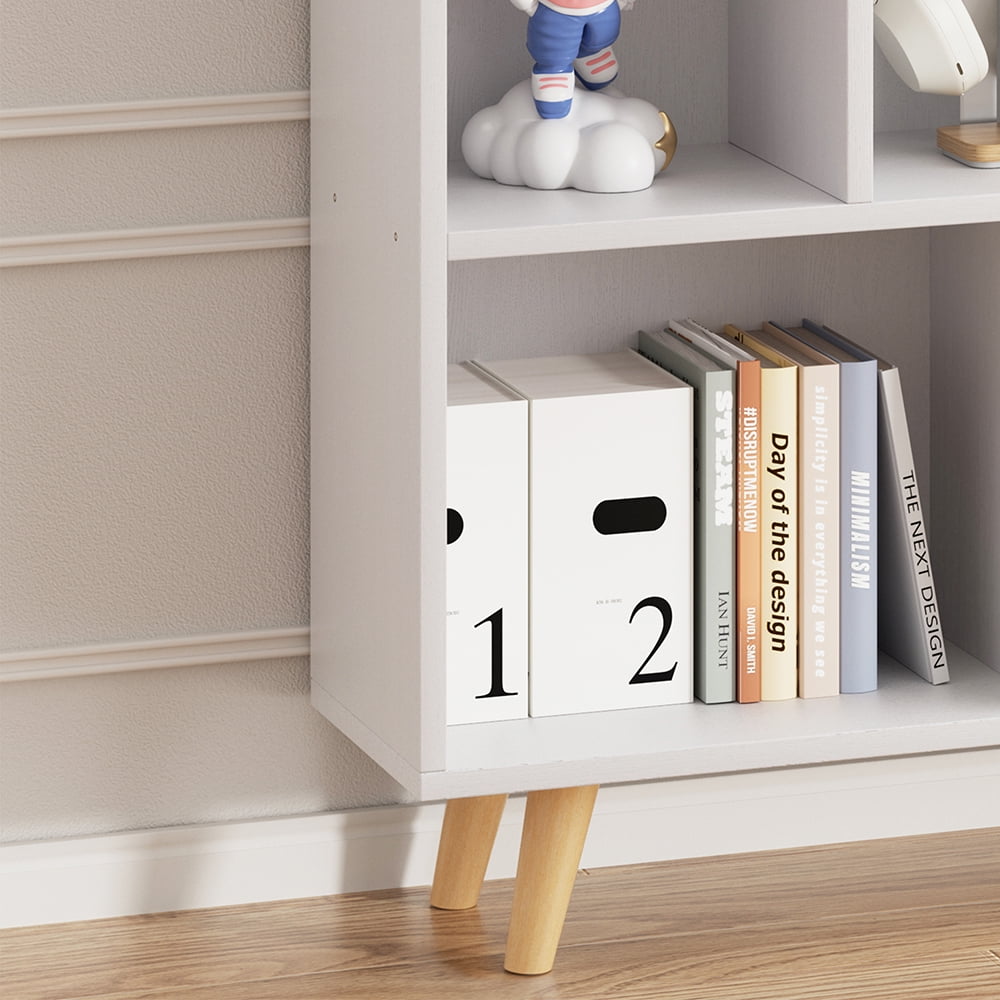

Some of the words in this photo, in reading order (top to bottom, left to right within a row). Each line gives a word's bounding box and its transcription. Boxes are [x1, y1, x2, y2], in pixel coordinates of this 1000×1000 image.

[812, 385, 828, 472] simplicity
[715, 390, 733, 526] STEAM
[744, 407, 757, 533] #DISRUPTMENOW
[767, 433, 789, 480] Day
[771, 489, 789, 515] of
[815, 479, 828, 493] is
[815, 500, 828, 515] in
[902, 470, 919, 514] THE
[771, 521, 789, 561] the
[851, 470, 871, 589] MINIMALISM
[910, 520, 930, 577] NEXT
[812, 522, 828, 614] everything
[747, 607, 756, 635] DAVID
[767, 569, 789, 652] design
[815, 621, 825, 644] we
[921, 586, 944, 669] DESIGN
[473, 608, 519, 699] 1
[628, 596, 678, 684] 2
[747, 644, 756, 674] SMITH
[815, 650, 825, 678] see
